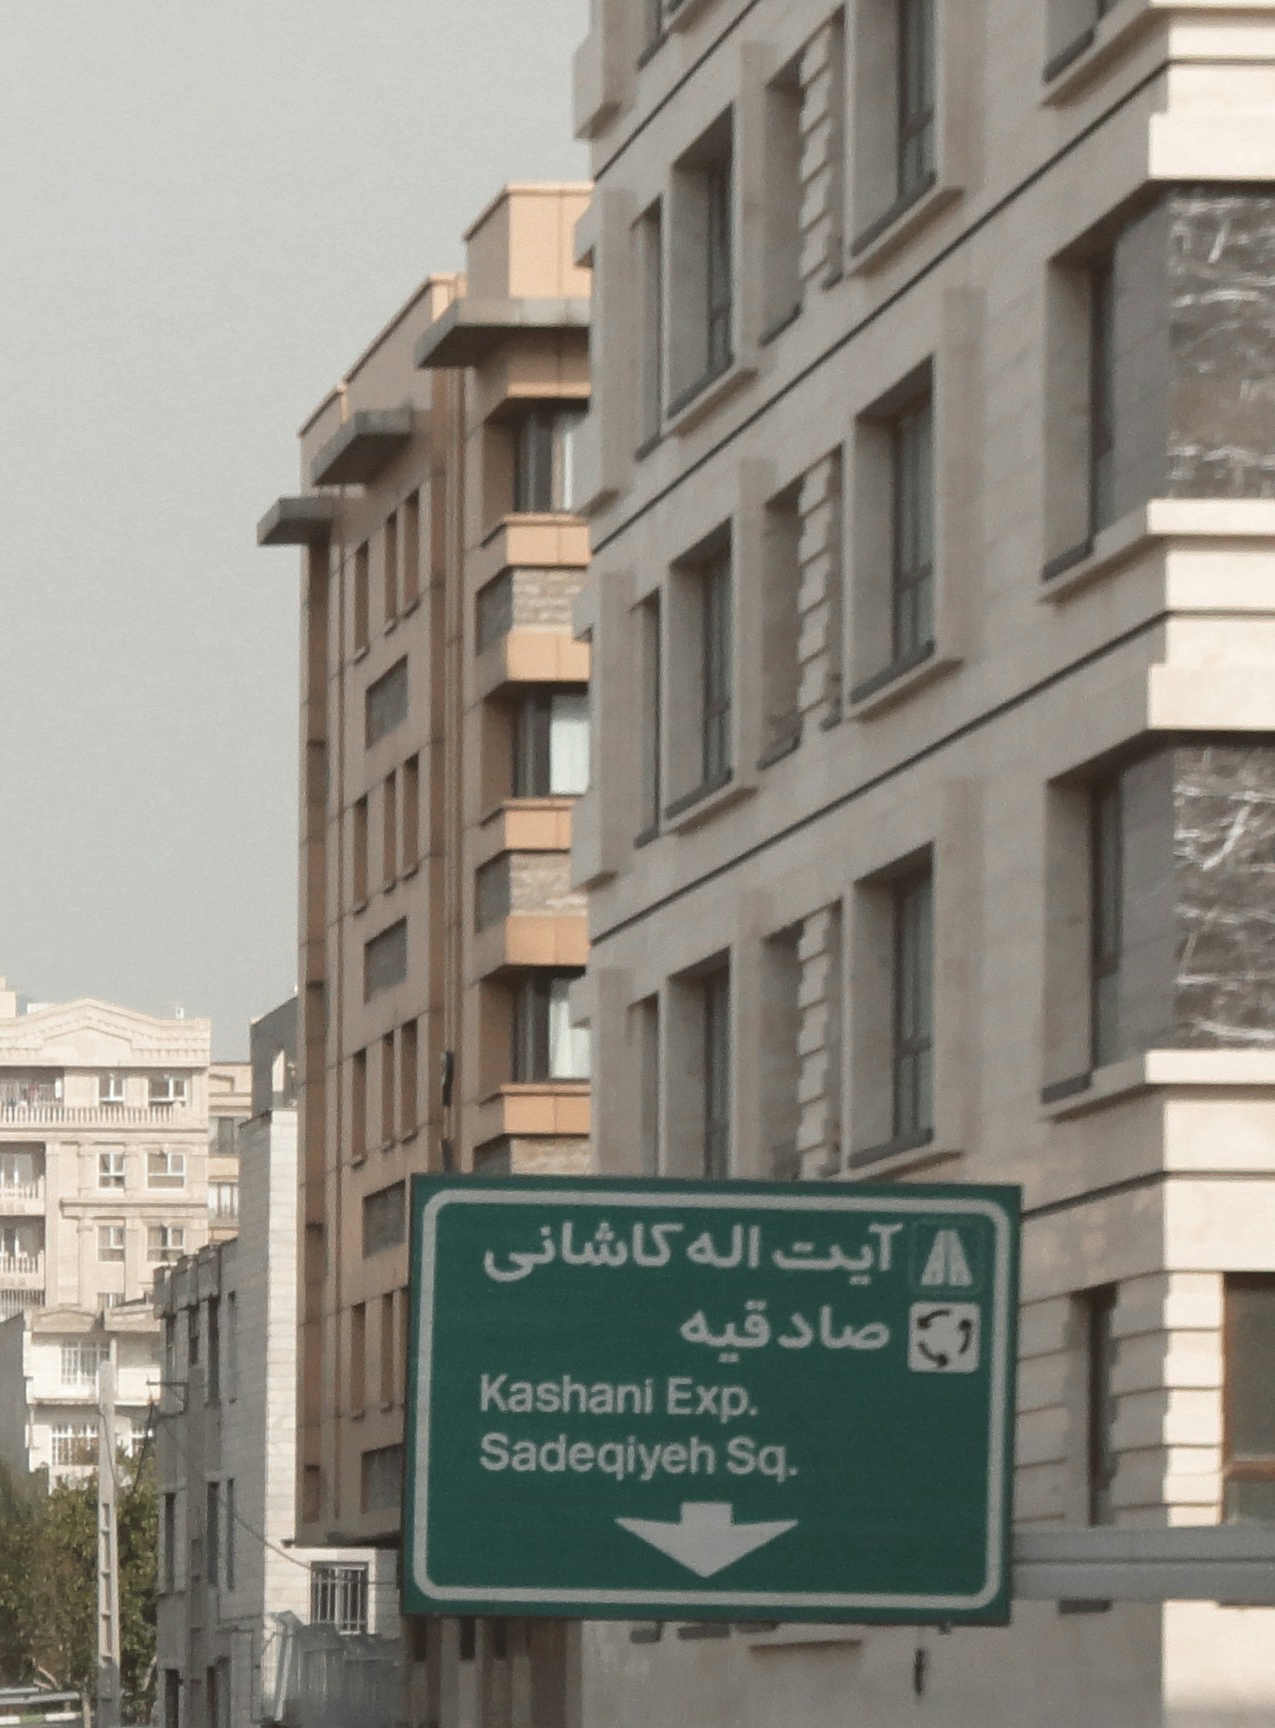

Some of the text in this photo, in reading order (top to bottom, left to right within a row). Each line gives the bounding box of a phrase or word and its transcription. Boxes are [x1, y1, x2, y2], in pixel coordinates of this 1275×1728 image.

[483, 1220, 904, 1286] آیت اله کاشانی
[680, 1299, 891, 1363] صادقیه
[479, 1374, 759, 1421] Kashani Exp.
[479, 1433, 798, 1482] Sadeqiyeh Sq.
